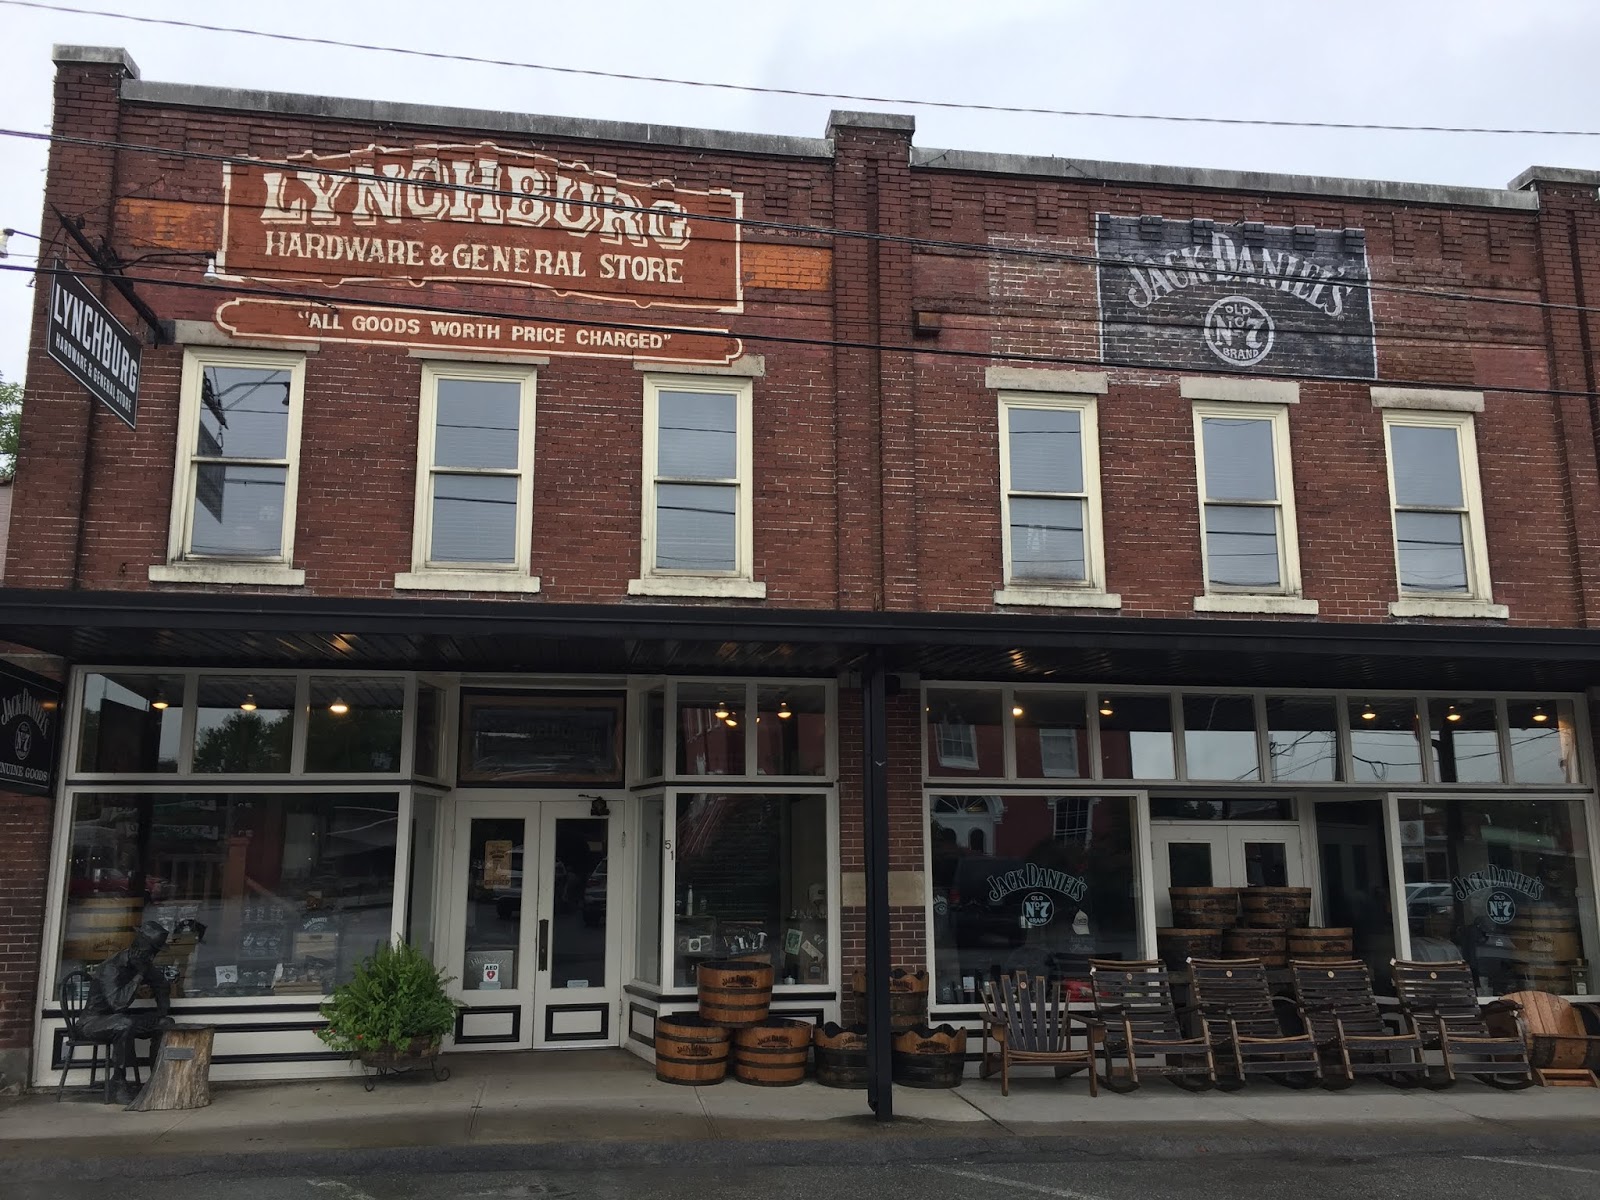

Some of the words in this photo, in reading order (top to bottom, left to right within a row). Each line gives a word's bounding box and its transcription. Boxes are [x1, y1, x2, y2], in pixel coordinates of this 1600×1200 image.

[260, 158, 691, 250] LYNCHBURG
[264, 230, 424, 267] HARDWARE
[430, 245, 445, 267] &
[452, 243, 586, 278] GENERAL
[600, 253, 684, 284] STORE
[1127, 245, 1211, 308] JACK
[1211, 231, 1353, 317] DANIEL'S
[352, 314, 420, 336] GOODS
[431, 320, 500, 340] WORTH
[511, 326, 565, 345] PRICE
[1225, 304, 1251, 316] OLD
[53, 283, 138, 393] LYNCHBURG
[1223, 347, 1259, 360] BRAND
[55, 332, 88, 373] HARDWARE
[87, 362, 93, 378] &
[93, 367, 116, 400] GENERAL
[116, 388, 132, 413] STORE
[25, 767, 48, 782] GOODS
[987, 868, 1027, 901] JACK
[1026, 863, 1088, 902] DANIEL'S
[1453, 870, 1489, 901] JACK
[1487, 864, 1544, 900] DANIEL'S
